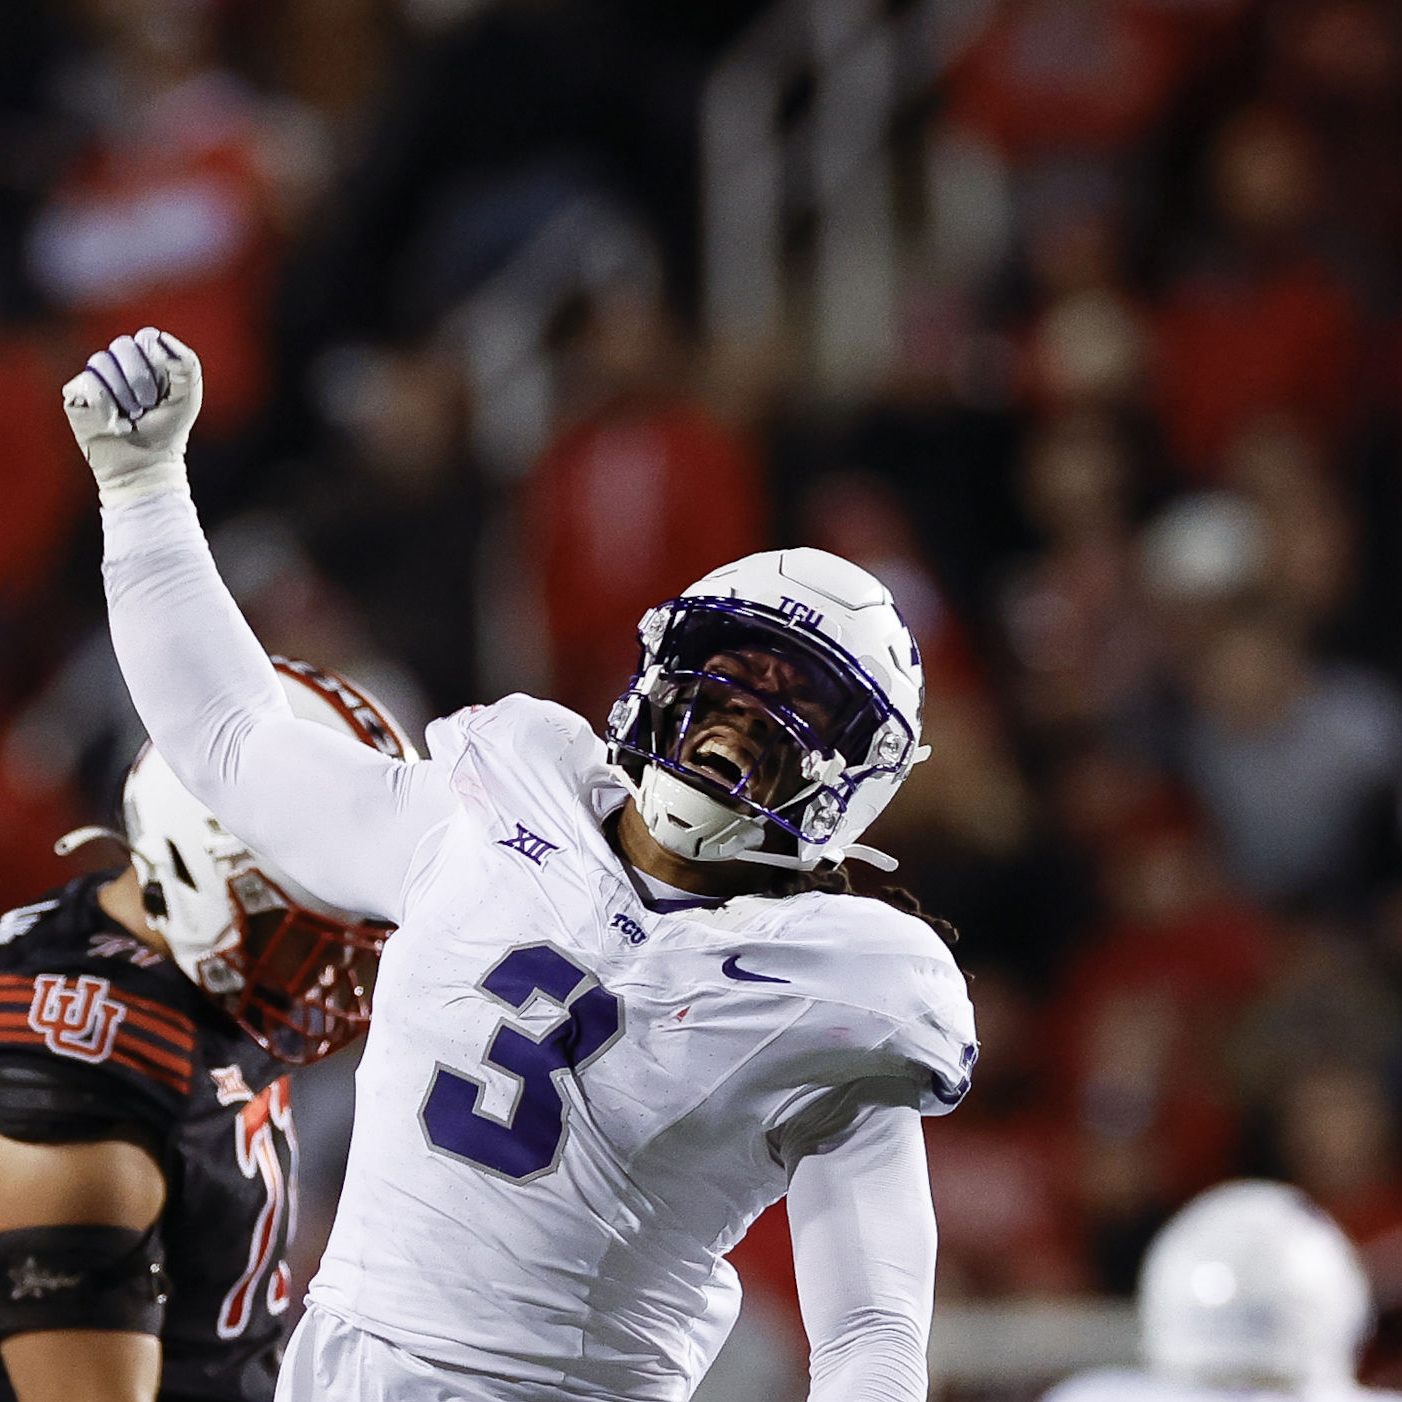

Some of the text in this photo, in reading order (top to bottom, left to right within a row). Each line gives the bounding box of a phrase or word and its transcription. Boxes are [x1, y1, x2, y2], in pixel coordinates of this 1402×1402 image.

[780, 596, 825, 628] TCU
[498, 824, 559, 866] XII
[610, 912, 648, 946] TCU
[417, 938, 626, 1187] 3
